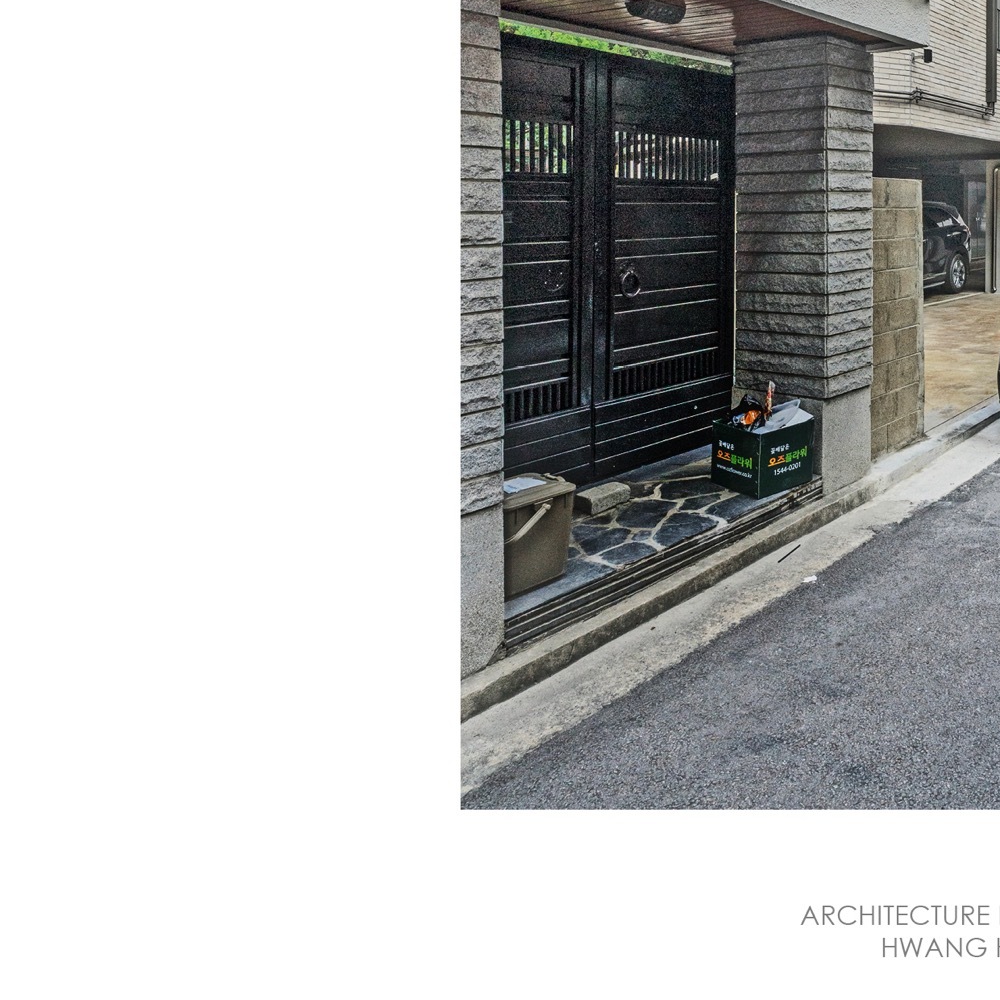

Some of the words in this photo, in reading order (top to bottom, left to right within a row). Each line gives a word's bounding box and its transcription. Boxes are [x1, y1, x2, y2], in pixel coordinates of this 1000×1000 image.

[717, 450, 752, 469] 오즈플라워
[768, 446, 807, 467] 오즈플라워
[774, 462, 801, 475] 1544-0201
